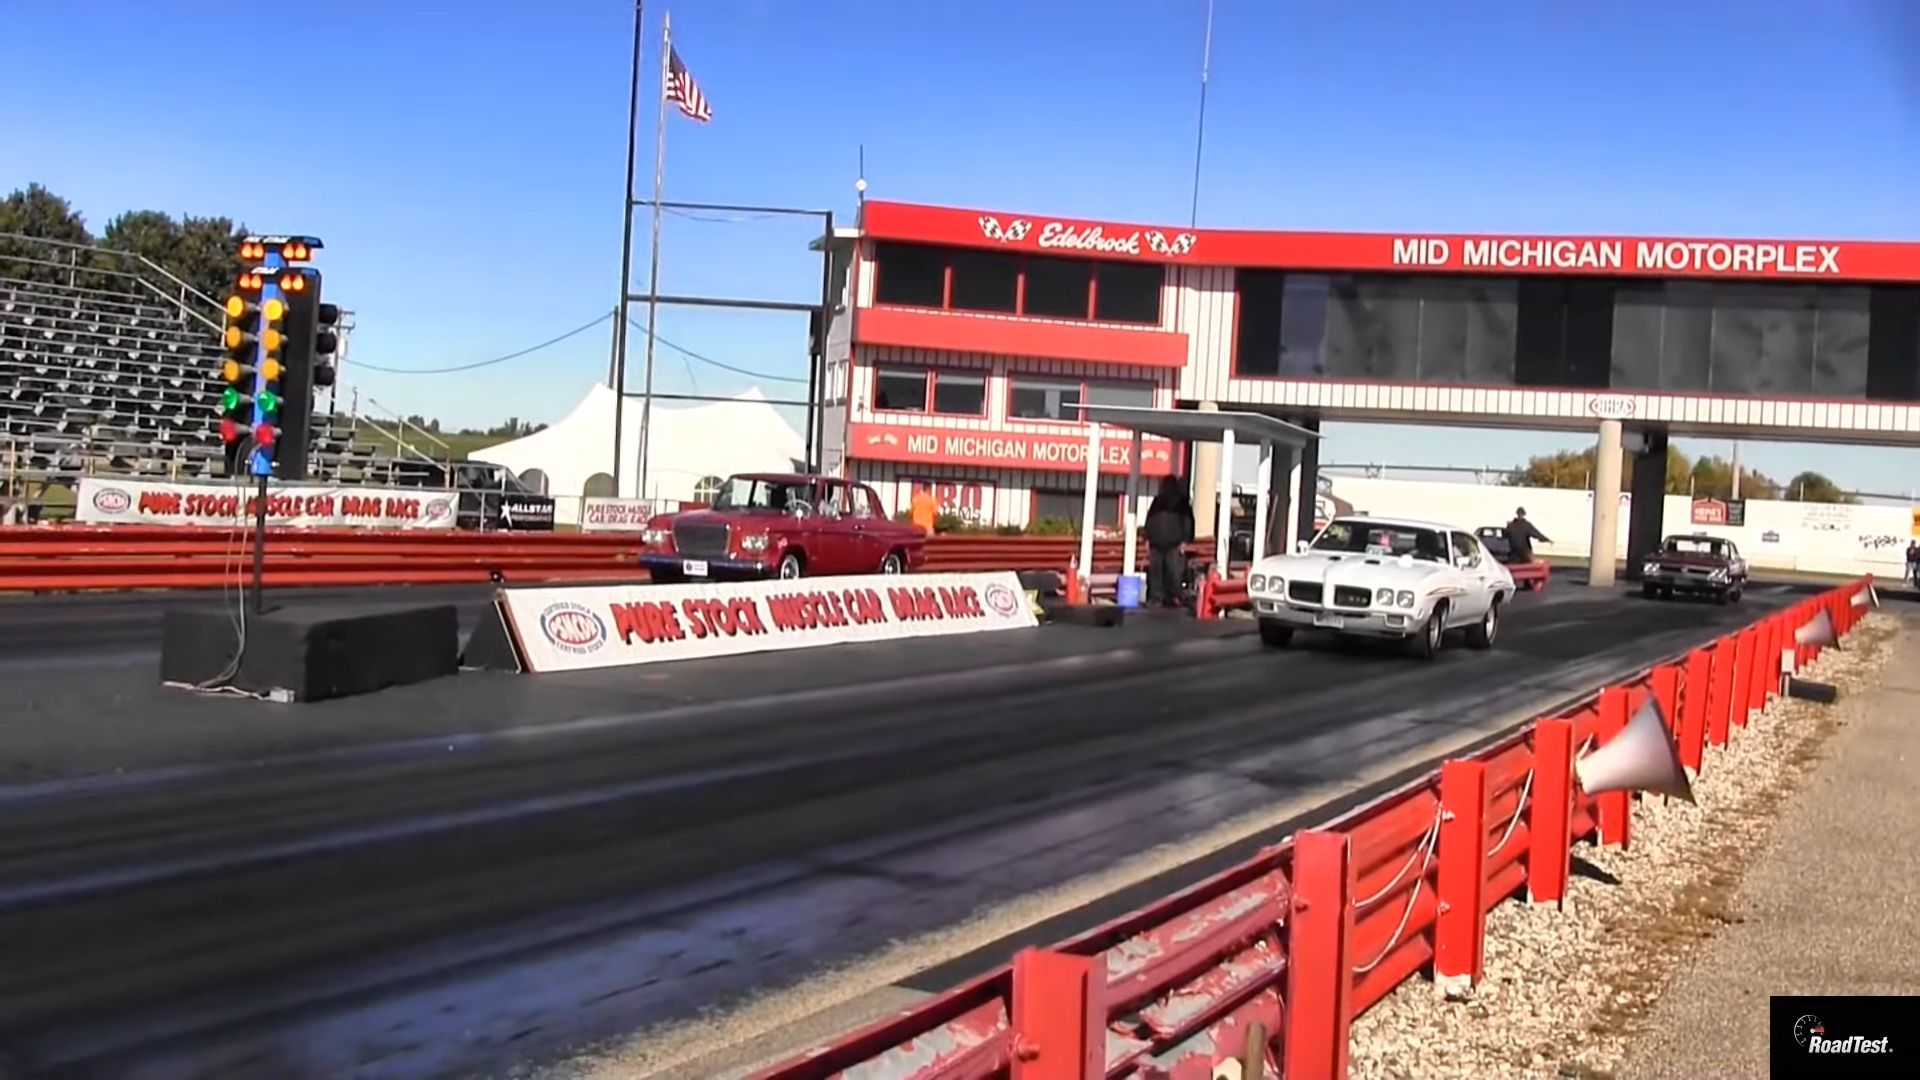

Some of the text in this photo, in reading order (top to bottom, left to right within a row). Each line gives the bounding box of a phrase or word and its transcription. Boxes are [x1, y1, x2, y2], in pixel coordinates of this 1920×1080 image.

[1038, 222, 1140, 255] Edelbrock
[1393, 239, 1840, 273] MID MICHIGAN MOTORPLEX
[908, 435, 1130, 465] MID MICHIGAN MOTORLEX
[139, 492, 182, 515] PURE
[184, 494, 240, 517] STOCK
[245, 495, 303, 517] MSCLE
[305, 495, 334, 517] CAR
[341, 496, 382, 517] DRAG
[386, 497, 420, 519] RACE
[511, 503, 553, 514] ALLSTAR
[610, 601, 686, 645] PURE
[682, 597, 768, 639] STOCK
[766, 590, 849, 632] MUSCLE
[842, 588, 888, 624] CAR
[887, 586, 943, 622] DRAG
[938, 585, 986, 618] RACE
